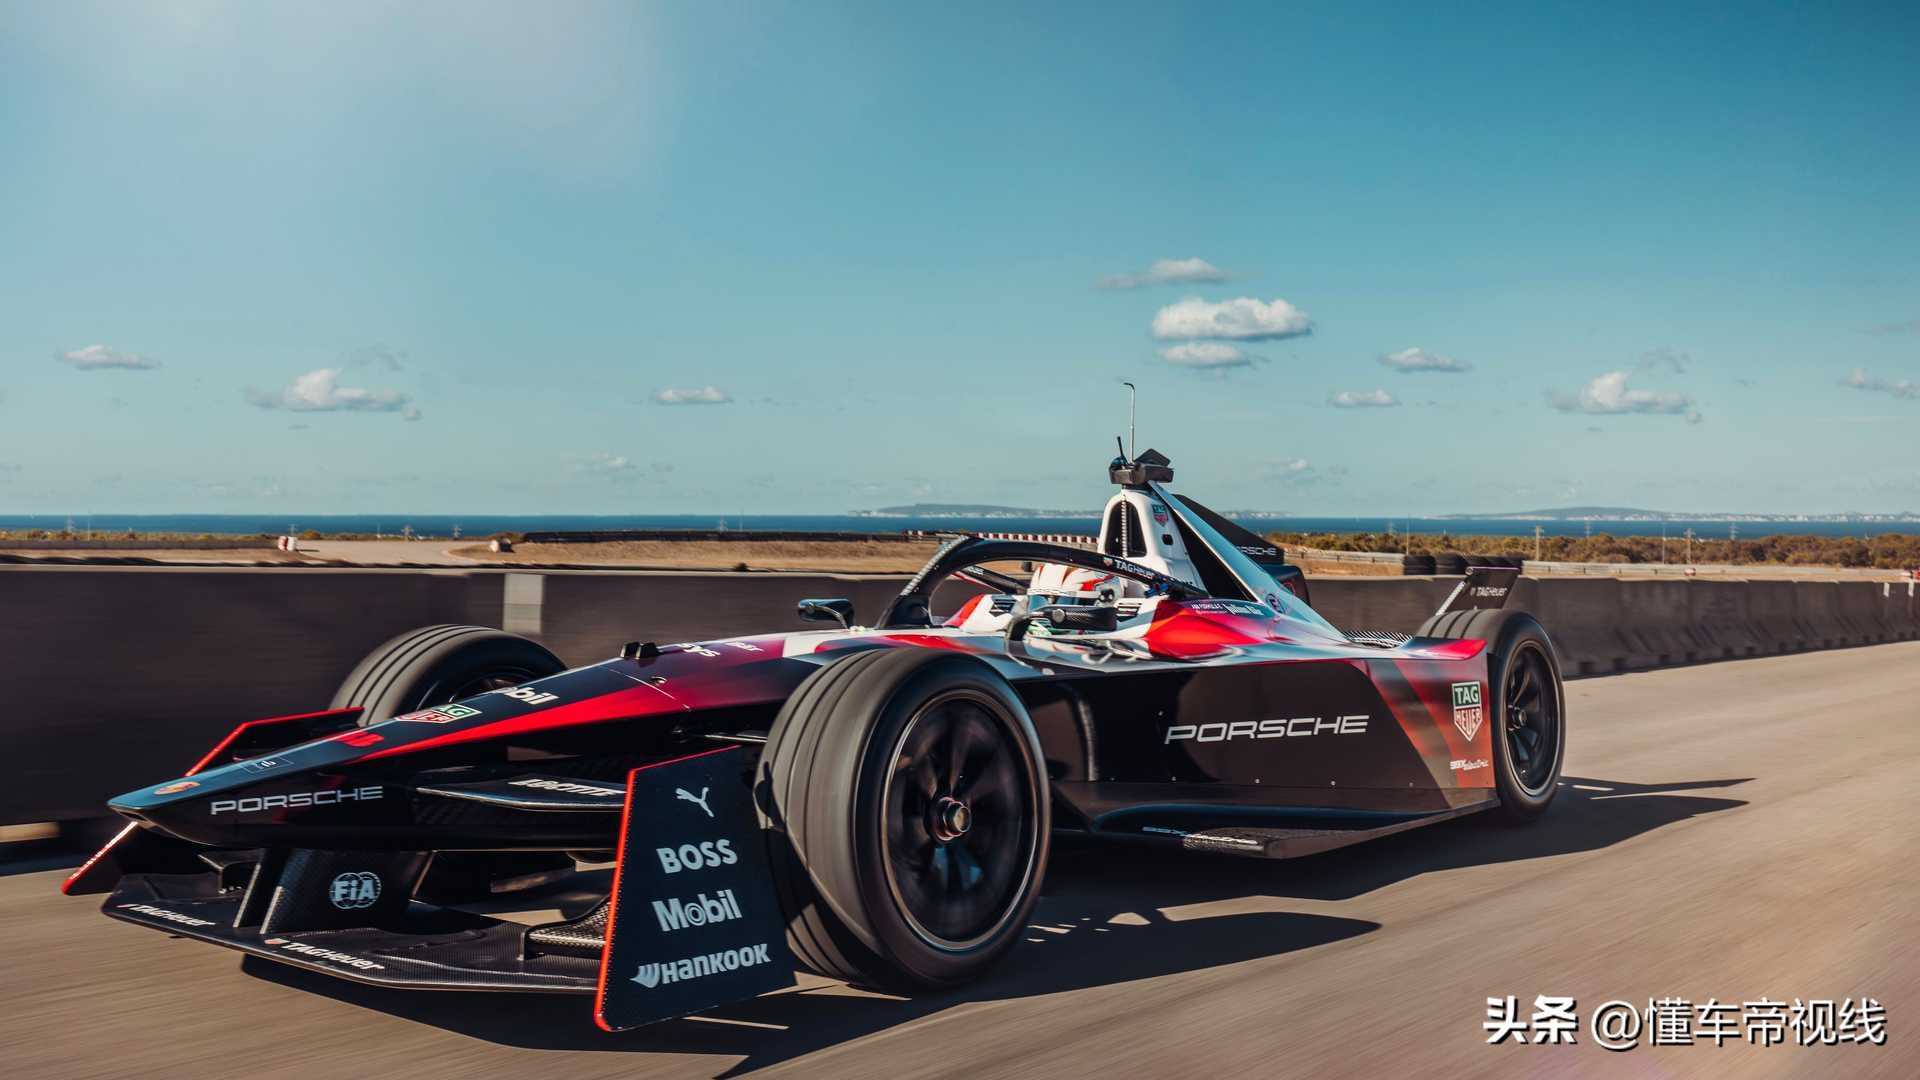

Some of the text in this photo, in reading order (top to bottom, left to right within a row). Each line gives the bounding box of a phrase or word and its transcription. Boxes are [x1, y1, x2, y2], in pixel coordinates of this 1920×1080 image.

[1454, 685, 1479, 705] TAG
[1163, 714, 1370, 745] PORSCHE
[1455, 707, 1481, 736] HEUER
[210, 785, 384, 816] PORSCHE
[656, 838, 738, 874] BOSS
[651, 888, 743, 932] Mobil
